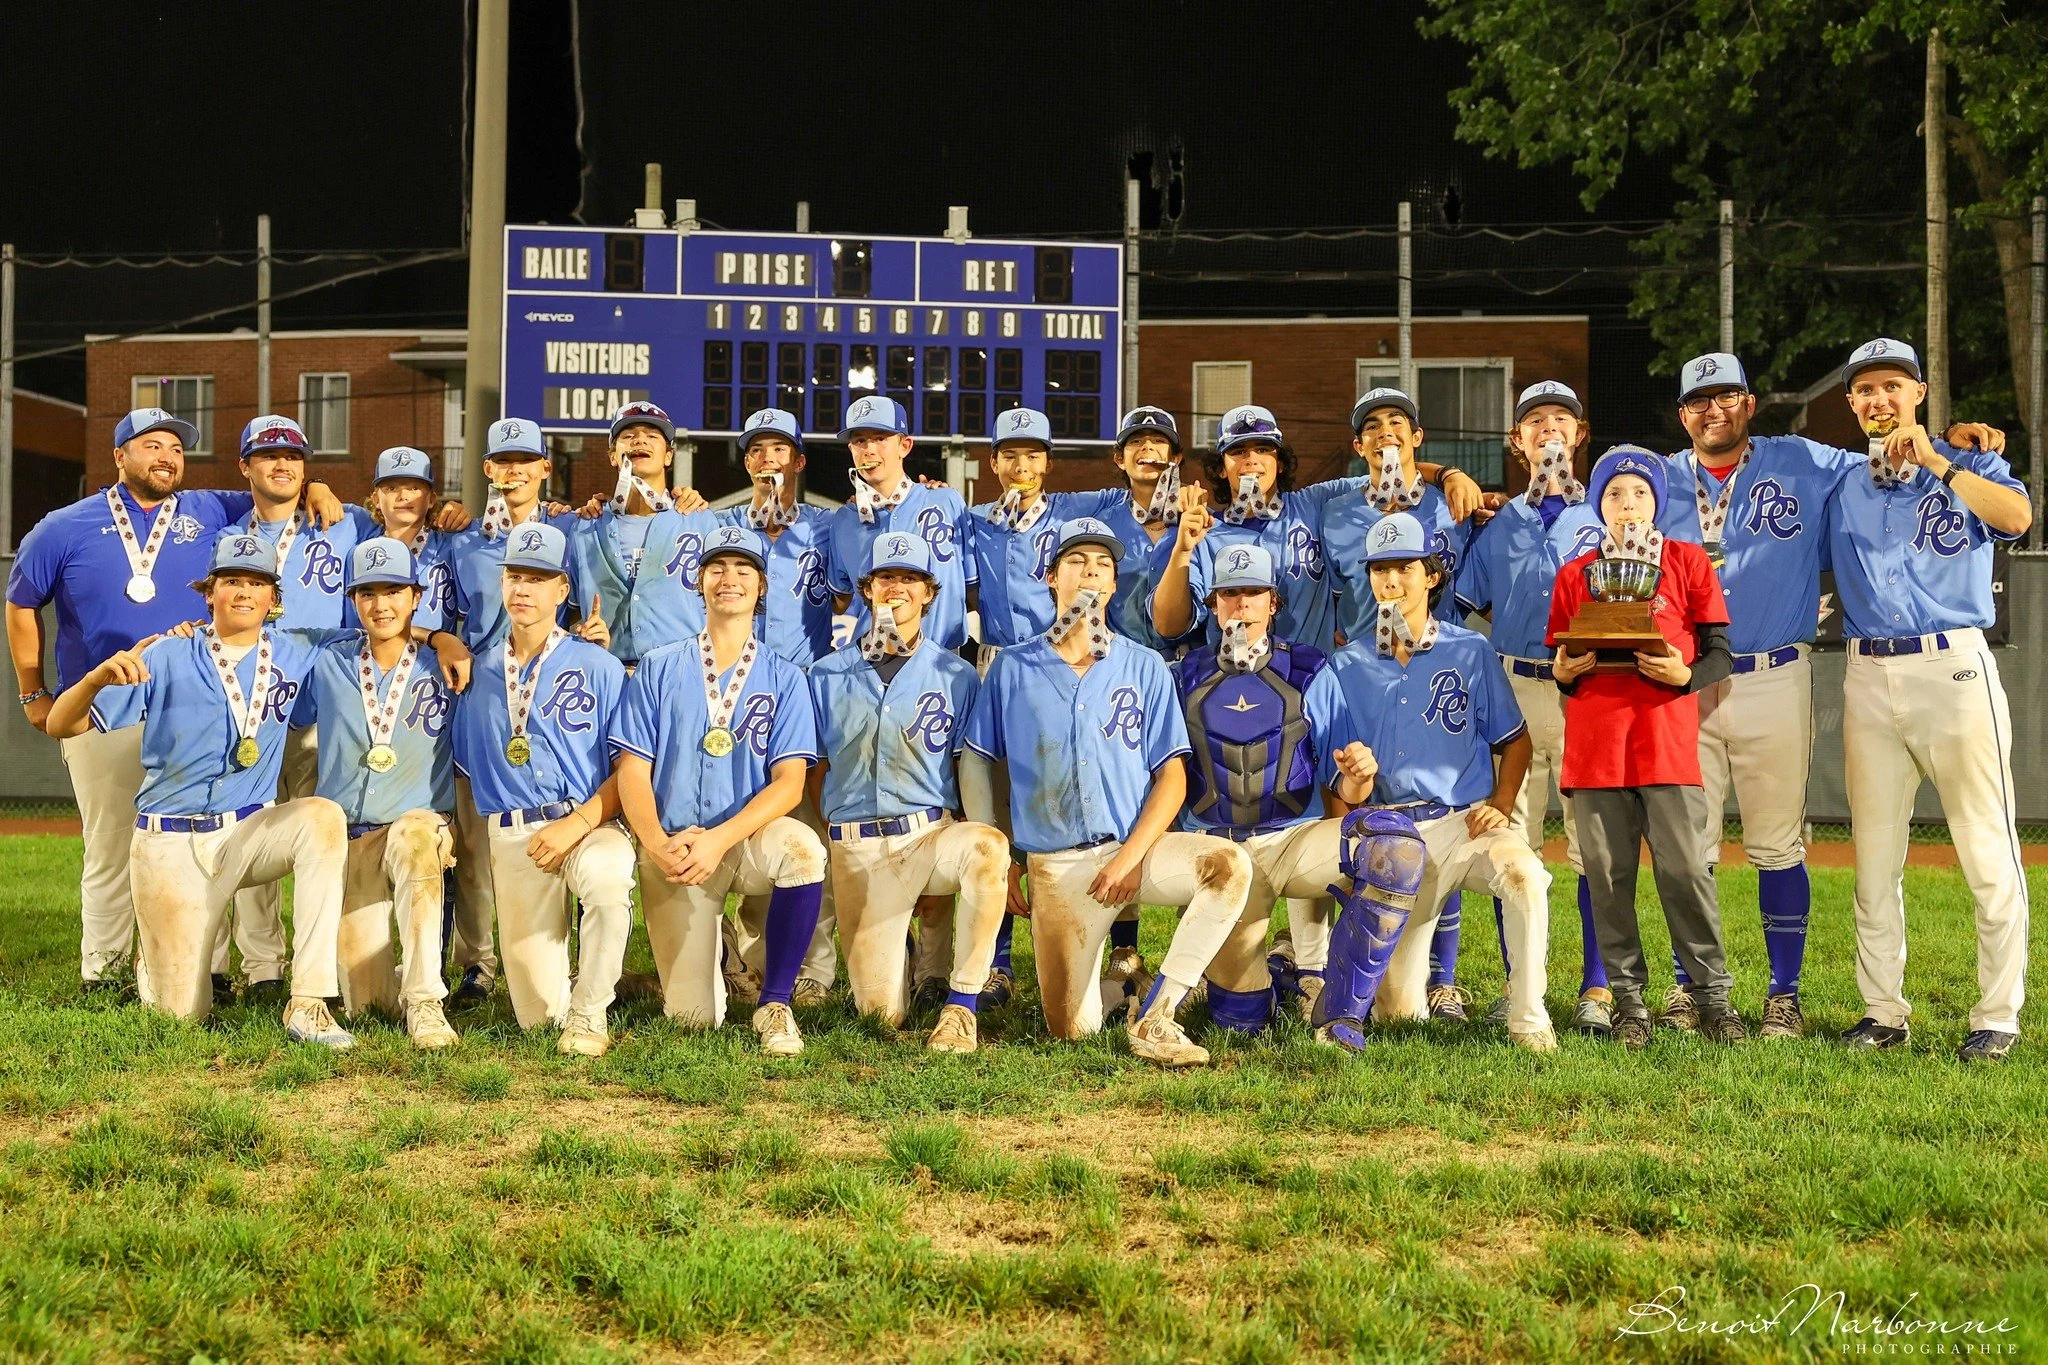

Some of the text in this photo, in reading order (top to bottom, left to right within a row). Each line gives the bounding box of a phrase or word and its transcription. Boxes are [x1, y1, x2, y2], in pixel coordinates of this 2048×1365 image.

[525, 247, 588, 280] BALLE
[722, 252, 805, 286] PRISE
[965, 260, 1015, 292] RET
[714, 303, 1102, 340] 1 2 3 4 5 6 7 8 9 TOTAL
[545, 341, 650, 376] VISITEURS
